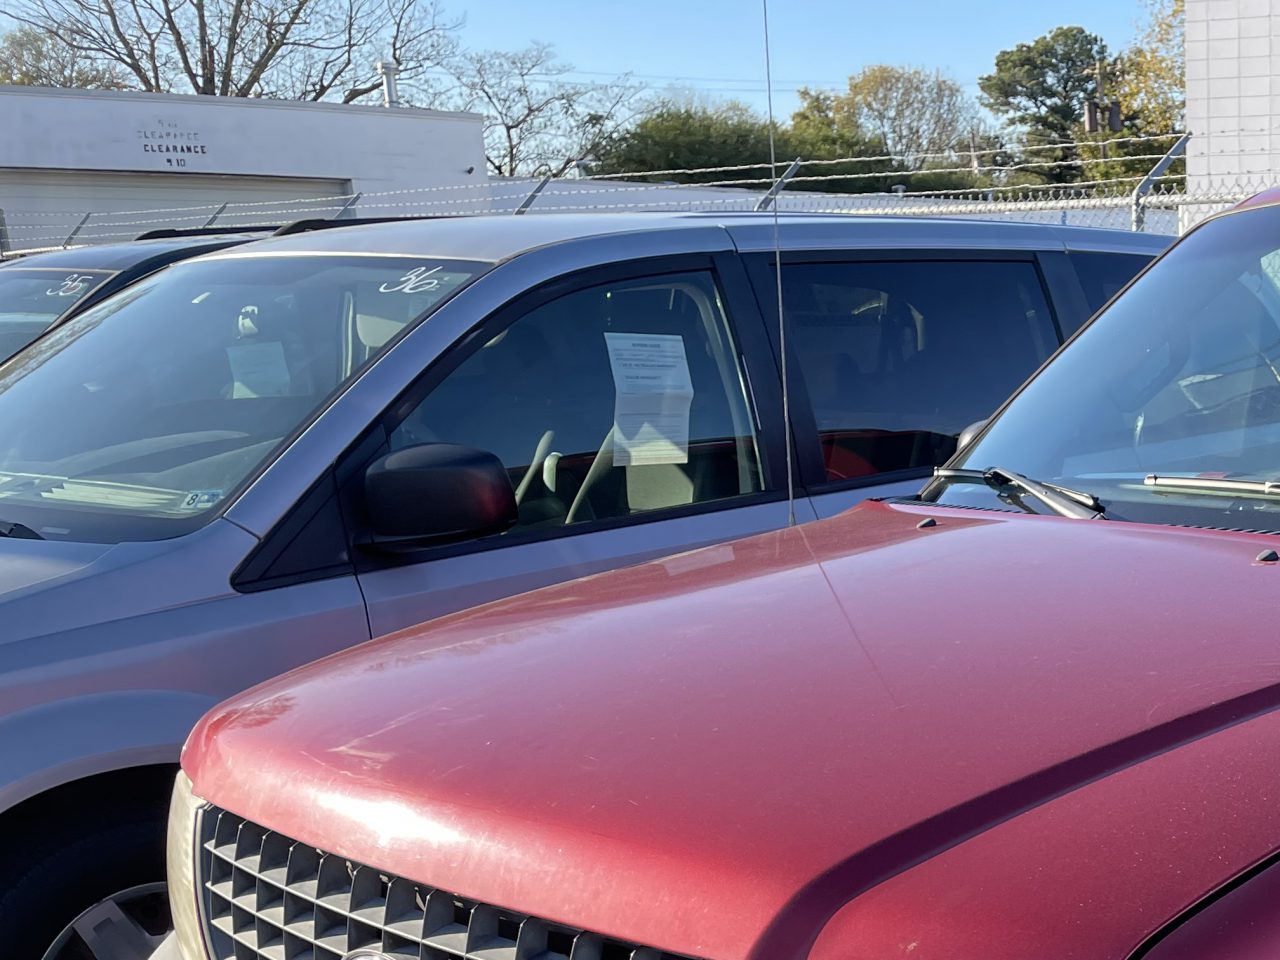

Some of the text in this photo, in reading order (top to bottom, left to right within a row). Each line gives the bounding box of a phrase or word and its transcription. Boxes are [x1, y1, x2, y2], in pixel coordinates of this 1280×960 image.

[143, 144, 207, 154] CLEARANCE
[46, 273, 93, 296] 35
[379, 265, 443, 293] 36
[187, 494, 198, 505] 8
